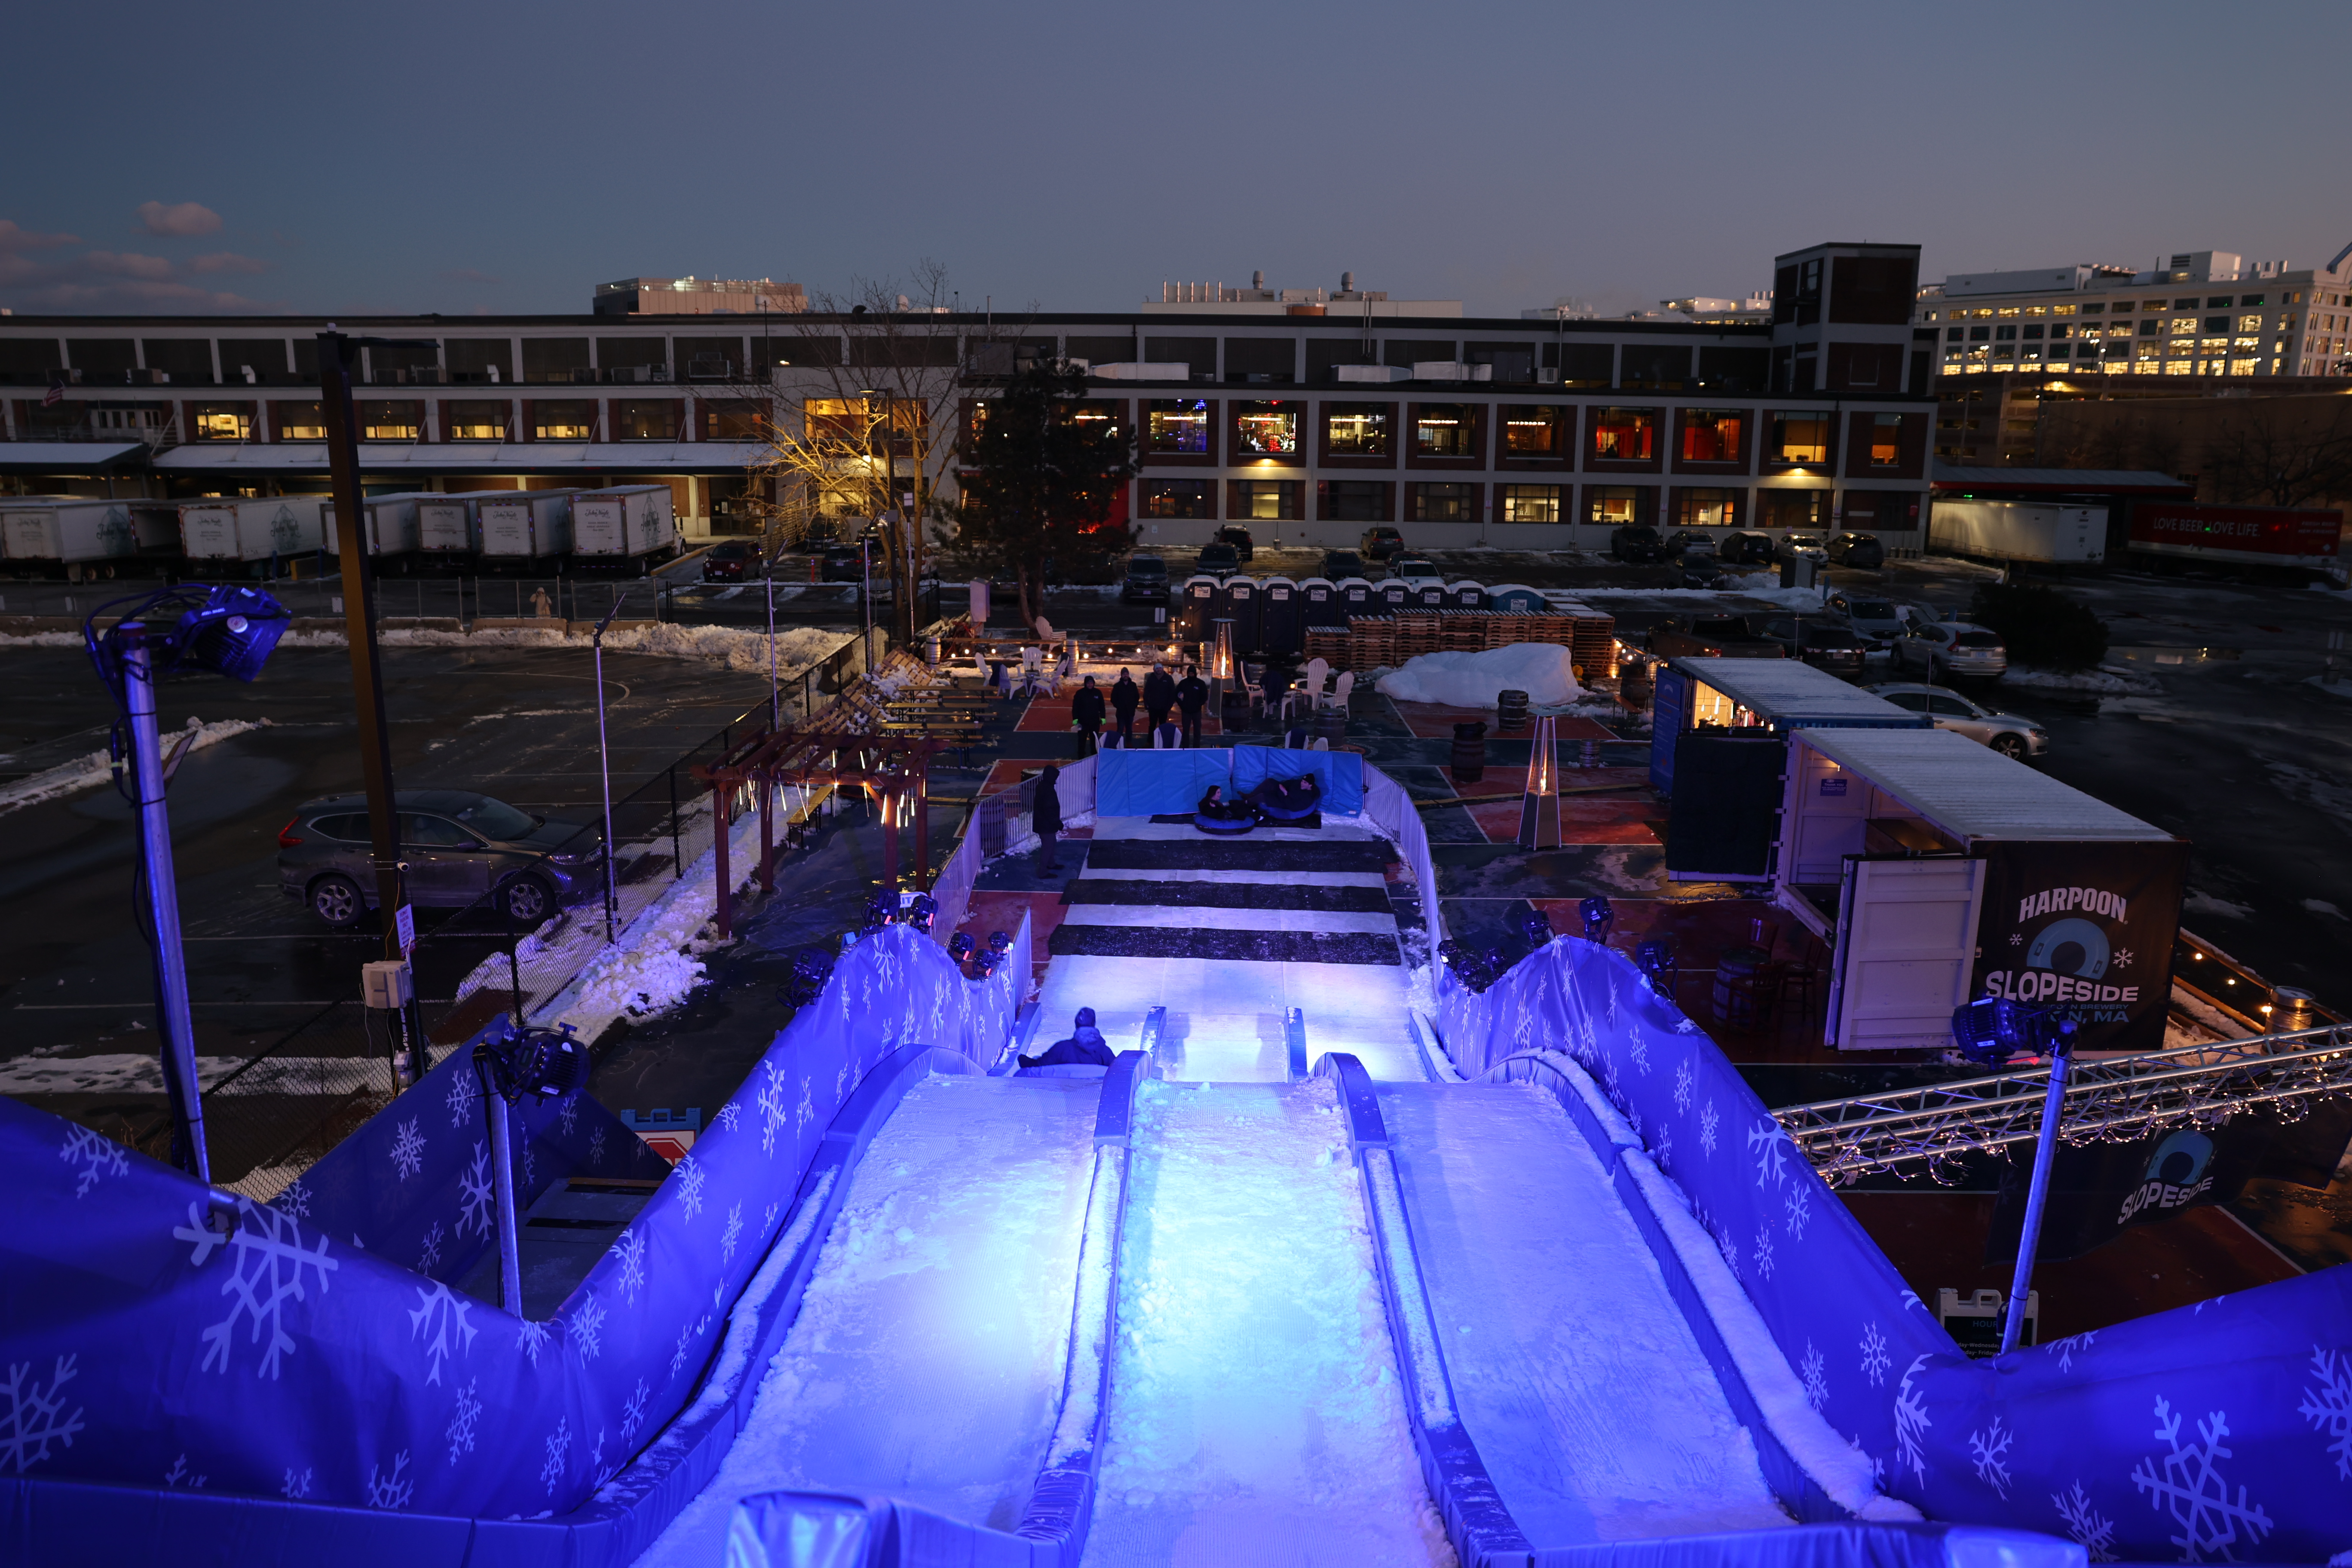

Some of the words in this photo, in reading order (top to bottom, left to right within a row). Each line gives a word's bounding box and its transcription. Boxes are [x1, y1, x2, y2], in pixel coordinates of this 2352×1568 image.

[2154, 517, 2177, 530] LOVE
[2179, 519, 2205, 532] BEER.
[2208, 521, 2235, 535] LOVE
[2237, 523, 2260, 537] LIFE.
[2019, 887, 2127, 923] HARPOON
[1986, 971, 2139, 1002] SLOPESIDE
[2094, 1011, 2129, 1023] MA
[2117, 1176, 2214, 1224] SLOPESIDE
